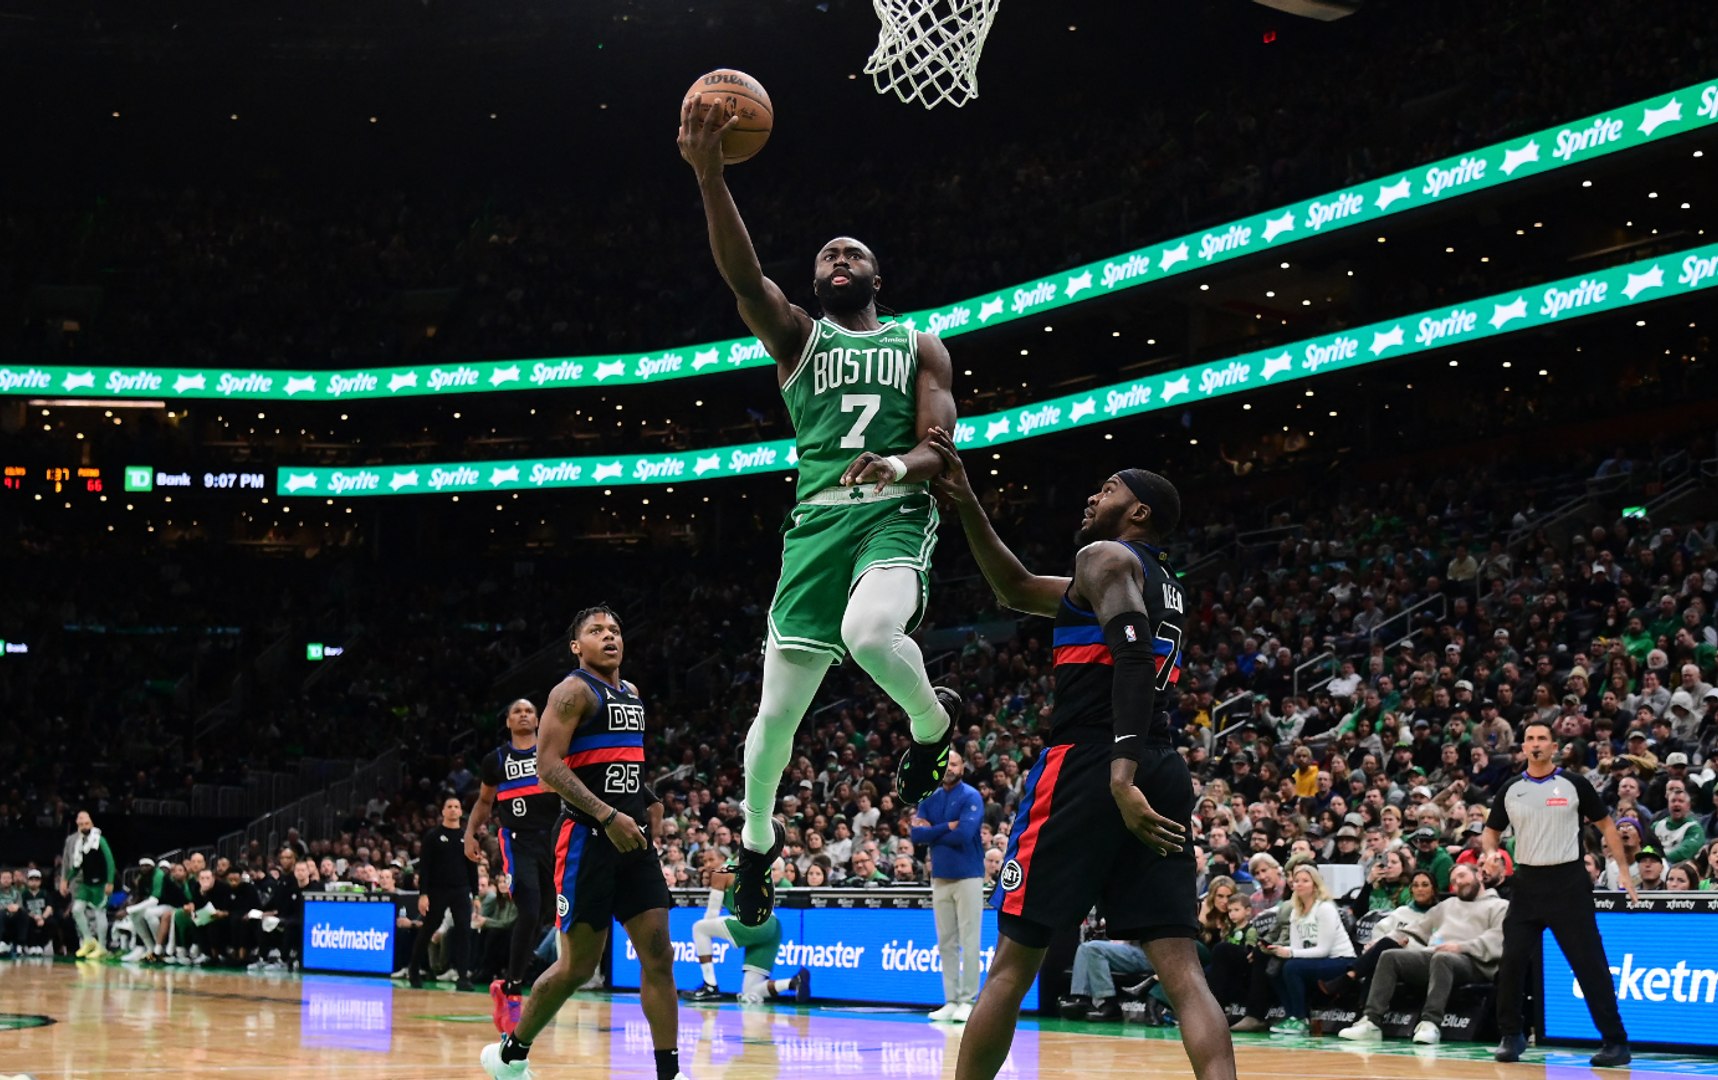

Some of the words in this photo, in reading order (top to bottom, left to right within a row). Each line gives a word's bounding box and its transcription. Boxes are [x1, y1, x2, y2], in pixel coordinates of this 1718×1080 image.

[926, 306, 970, 336] Sprite
[1012, 283, 1056, 314] Sprite
[1101, 256, 1149, 288] Sprite
[1199, 227, 1251, 260] Sprite
[1306, 194, 1363, 231] Sprite
[1424, 158, 1486, 197] Sprite
[1553, 118, 1624, 160] Sprite
[814, 347, 911, 395] BOSTON
[1018, 406, 1061, 434] Sprite
[1105, 384, 1151, 416] Sprite
[1200, 363, 1249, 394] Sprite
[1303, 337, 1358, 370] Sprite
[1416, 310, 1477, 345] Sprite
[1541, 280, 1608, 317] Sprite
[0, 368, 51, 391] Sprite
[106, 371, 162, 393] Sprite
[217, 374, 273, 395] Sprite
[327, 374, 378, 396] Sprite
[427, 367, 479, 391] Sprite
[530, 362, 583, 385] Sprite
[635, 353, 683, 379] Sprite
[840, 394, 881, 449] 7
[87, 479, 103, 492] 66
[128, 470, 151, 487] TD
[156, 472, 191, 486] Bank
[204, 472, 237, 488] 9:07
[240, 473, 265, 488] PM
[328, 472, 380, 494] Sprite
[429, 466, 479, 490] Sprite
[530, 462, 582, 485] Sprite
[633, 457, 684, 480] Sprite
[729, 448, 776, 473] Sprite
[607, 703, 646, 731] DET
[605, 763, 641, 794] 25
[512, 797, 527, 817] 9
[1665, 899, 1696, 910] xfinity
[311, 922, 389, 951] ticketmaster
